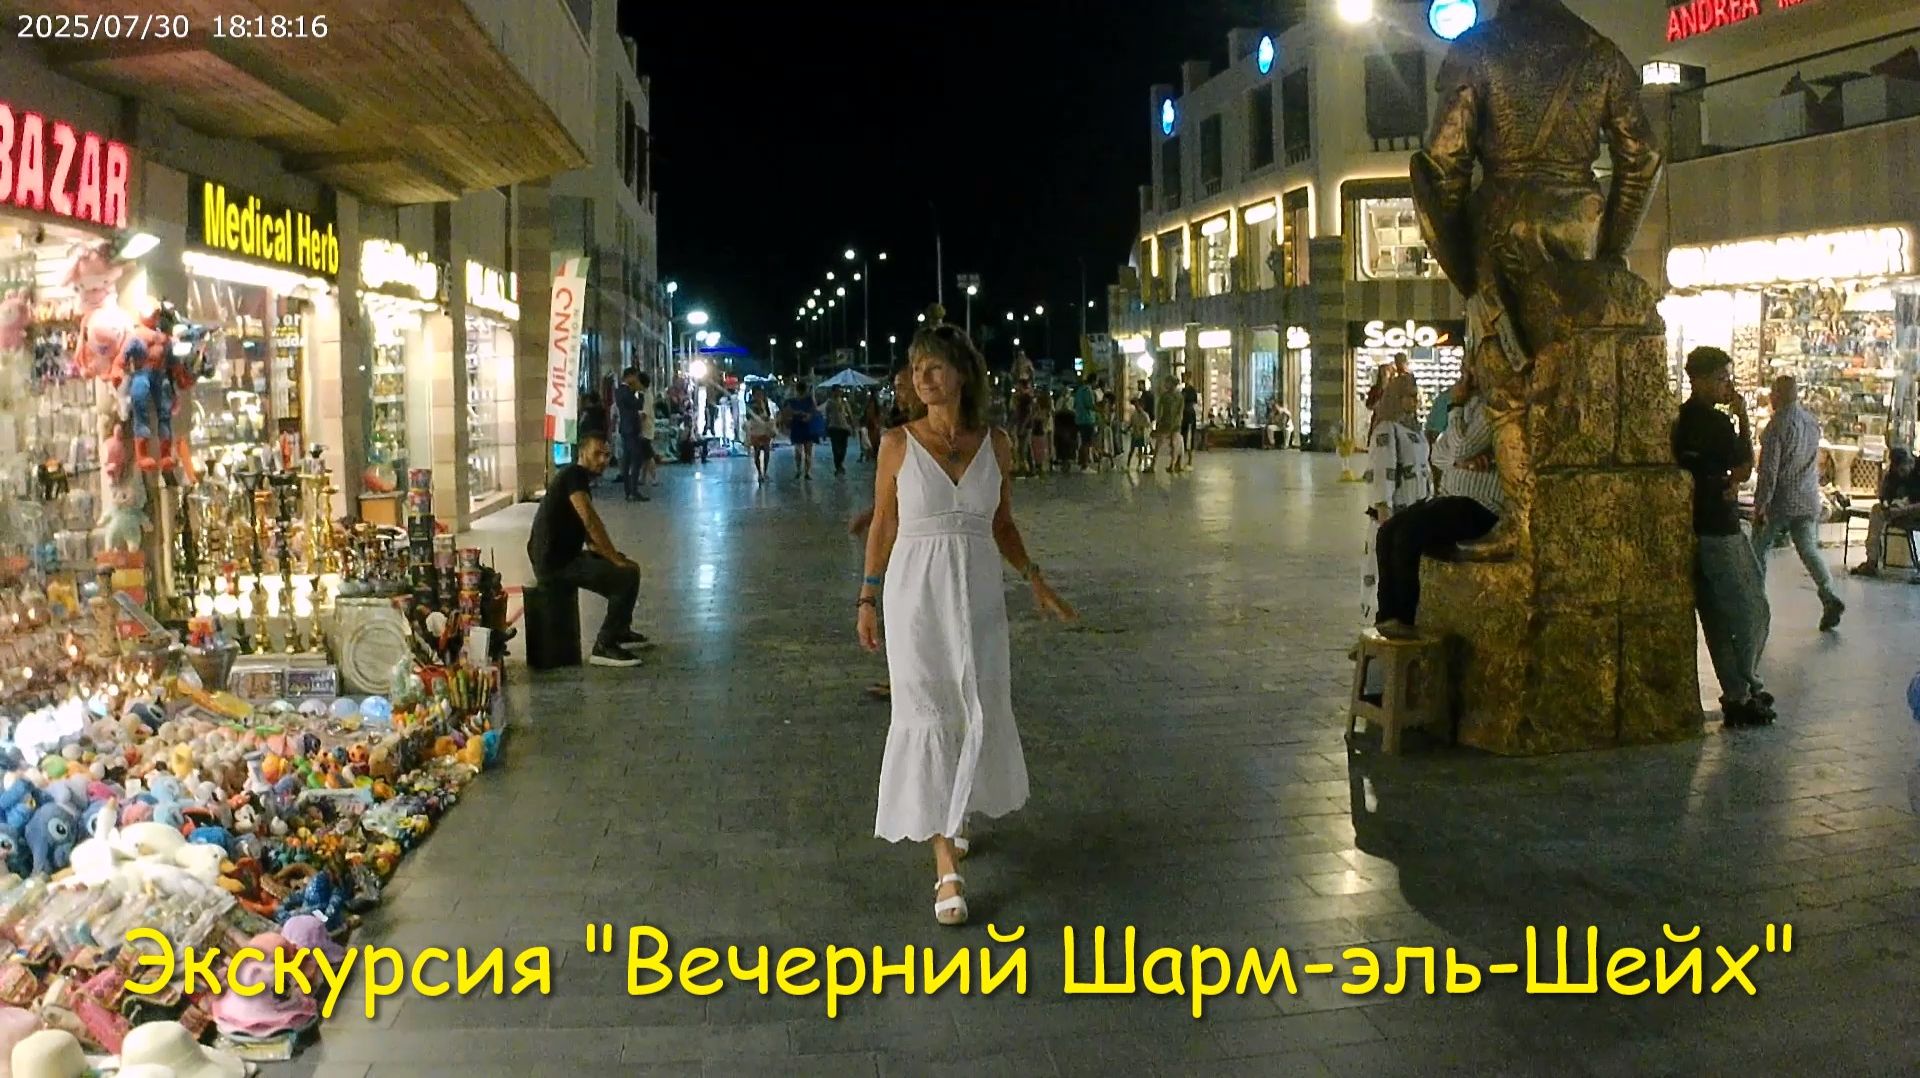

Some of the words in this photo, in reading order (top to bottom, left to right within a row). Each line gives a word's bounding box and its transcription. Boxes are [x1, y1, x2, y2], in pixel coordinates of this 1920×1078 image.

[1666, 0, 1761, 42] ANDREA
[204, 181, 293, 264] Medical
[297, 211, 339, 274] Herb
[1363, 319, 1439, 348] Solo
